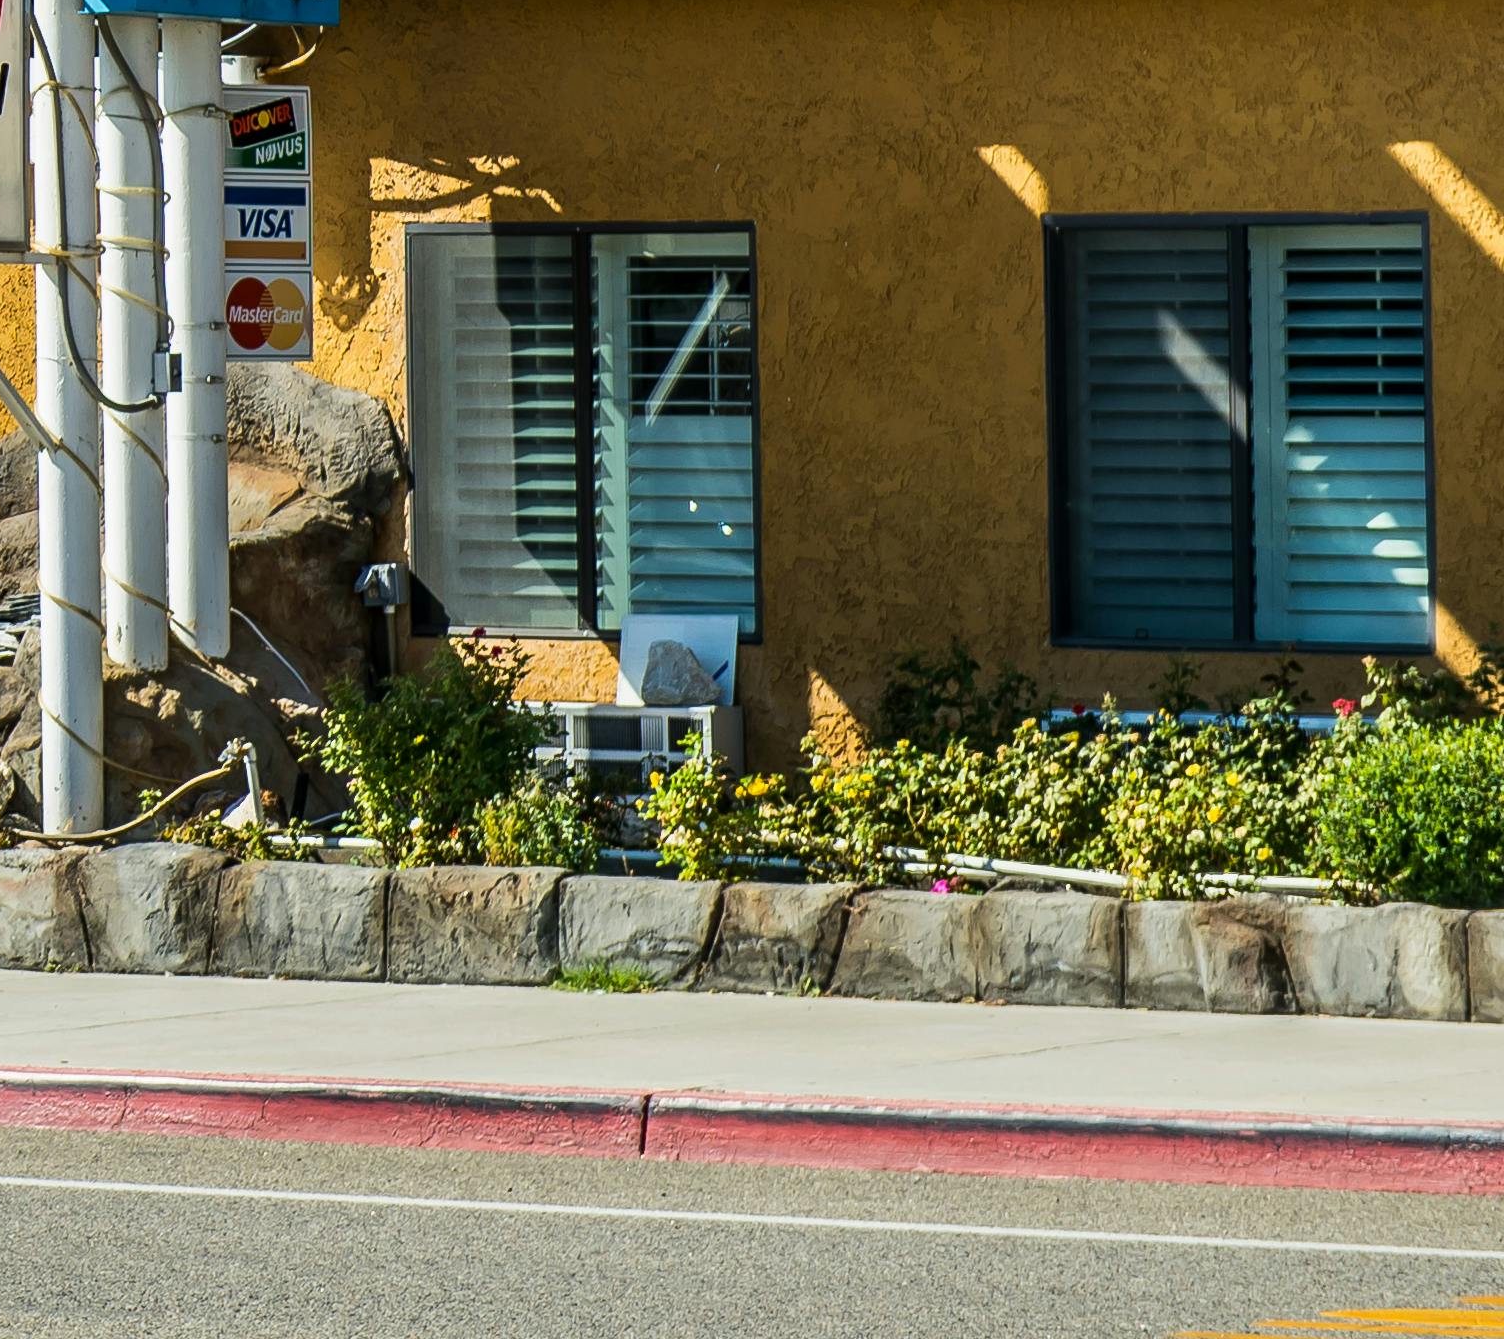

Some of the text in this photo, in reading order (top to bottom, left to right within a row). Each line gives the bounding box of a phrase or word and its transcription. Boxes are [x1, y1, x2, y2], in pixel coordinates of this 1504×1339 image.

[232, 102, 293, 138] DISCOVER
[238, 208, 293, 239] VISA
[228, 304, 304, 324] MasterCard
